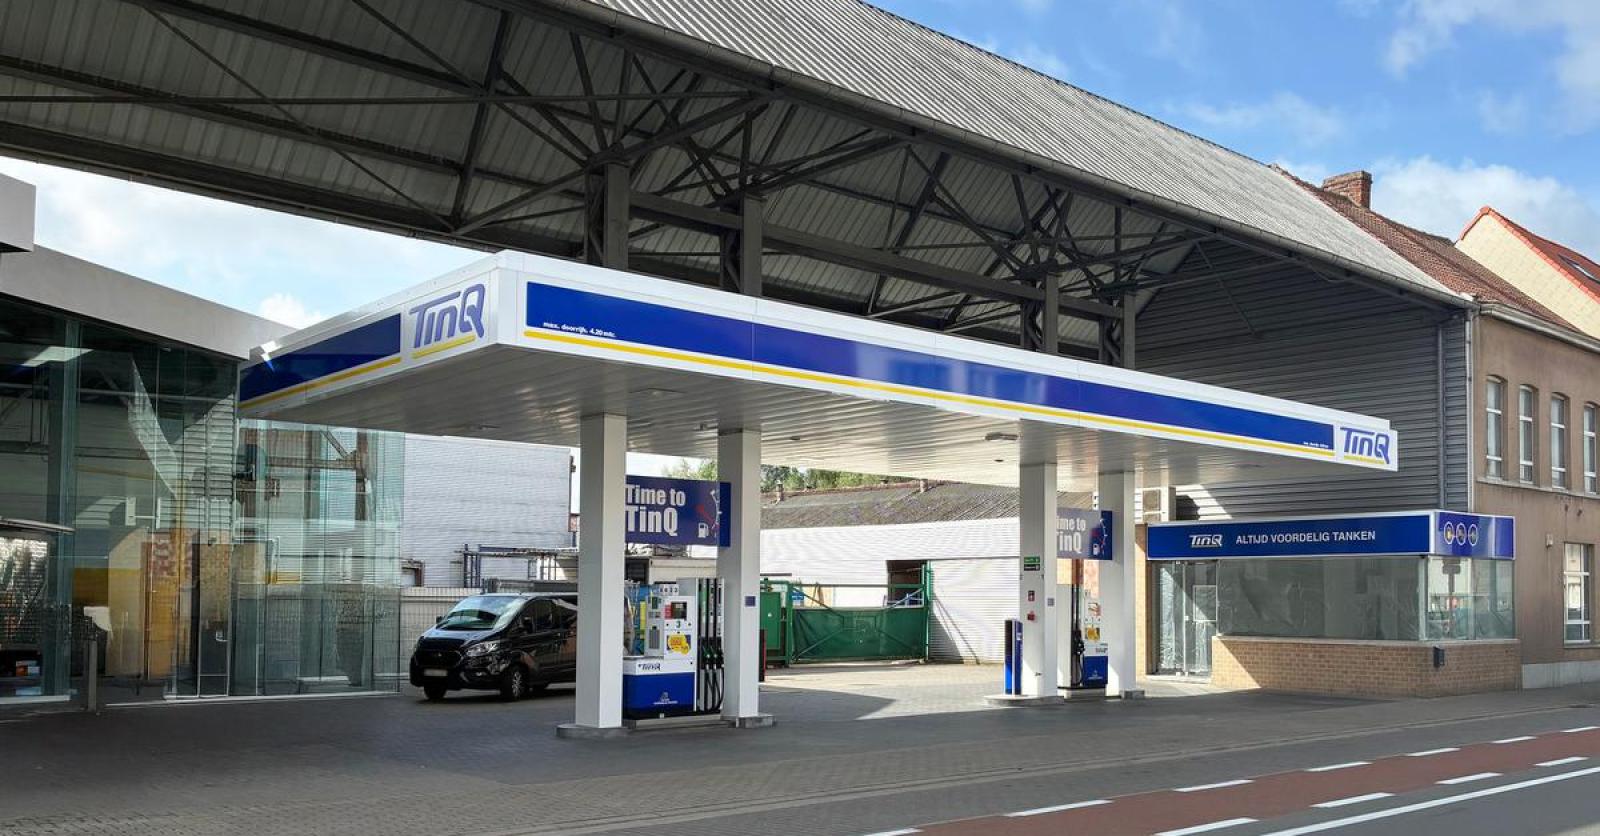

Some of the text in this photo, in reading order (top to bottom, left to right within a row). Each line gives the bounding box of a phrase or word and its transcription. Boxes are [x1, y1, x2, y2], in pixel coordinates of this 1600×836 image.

[409, 283, 485, 348] TinQ
[1340, 427, 1390, 464] TinQ
[625, 484, 686, 506] Time to
[625, 505, 678, 536] TinQ
[1056, 515, 1086, 531] ime to
[1056, 531, 1082, 553] inQ
[1189, 531, 1376, 548] TinQ ALTIJD VOORDELIG TANKEN
